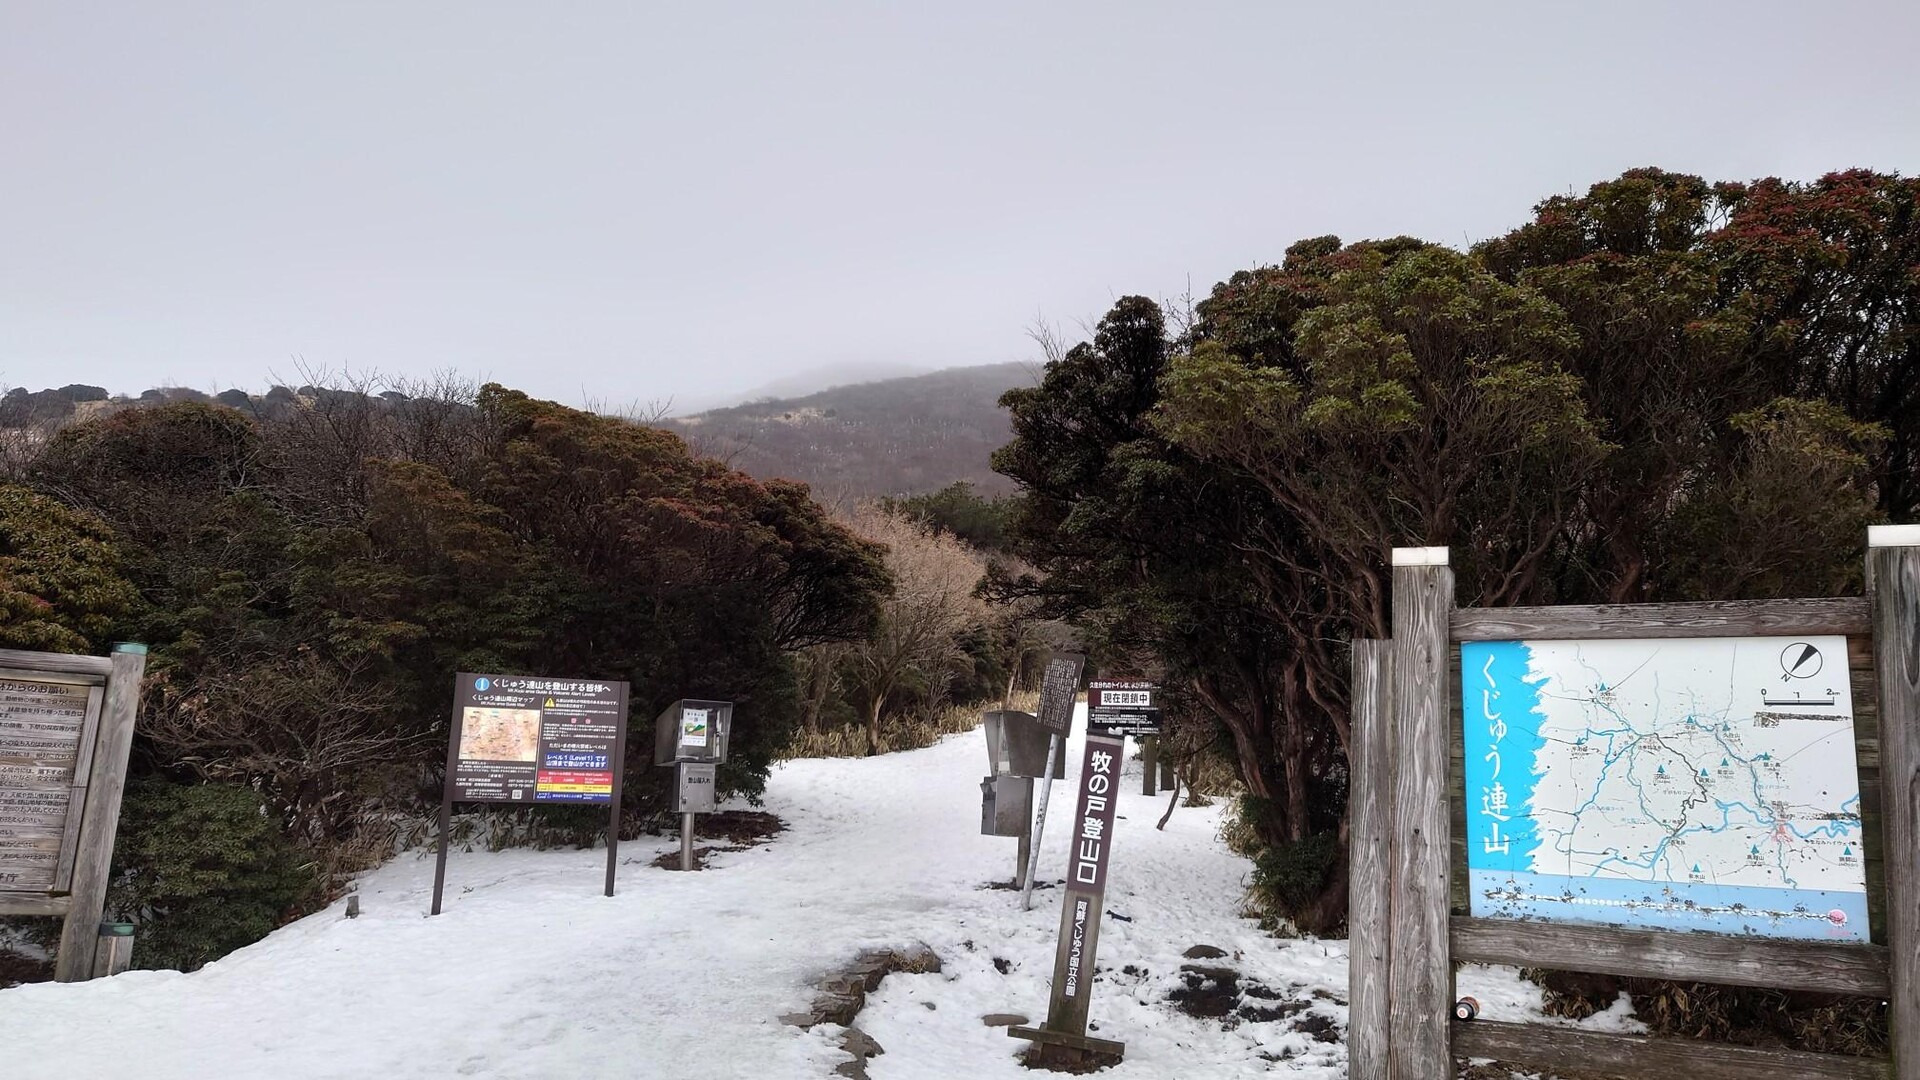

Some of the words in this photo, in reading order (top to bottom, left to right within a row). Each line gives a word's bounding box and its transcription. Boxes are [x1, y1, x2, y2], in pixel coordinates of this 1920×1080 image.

[1780, 673, 1791, 683] N
[492, 678, 613, 693] くじゅう連山を登山する皆様へ
[1760, 688, 1767, 696] 0
[472, 694, 537, 704] くじゅう連山周辺マップ
[1103, 692, 1148, 704] 現在閉鎖中
[1480, 654, 1510, 857] くじゅう連山
[1077, 750, 1113, 884] 牧の戸登山口
[1065, 900, 1088, 997] 阿蘇くじゅう国立公園
